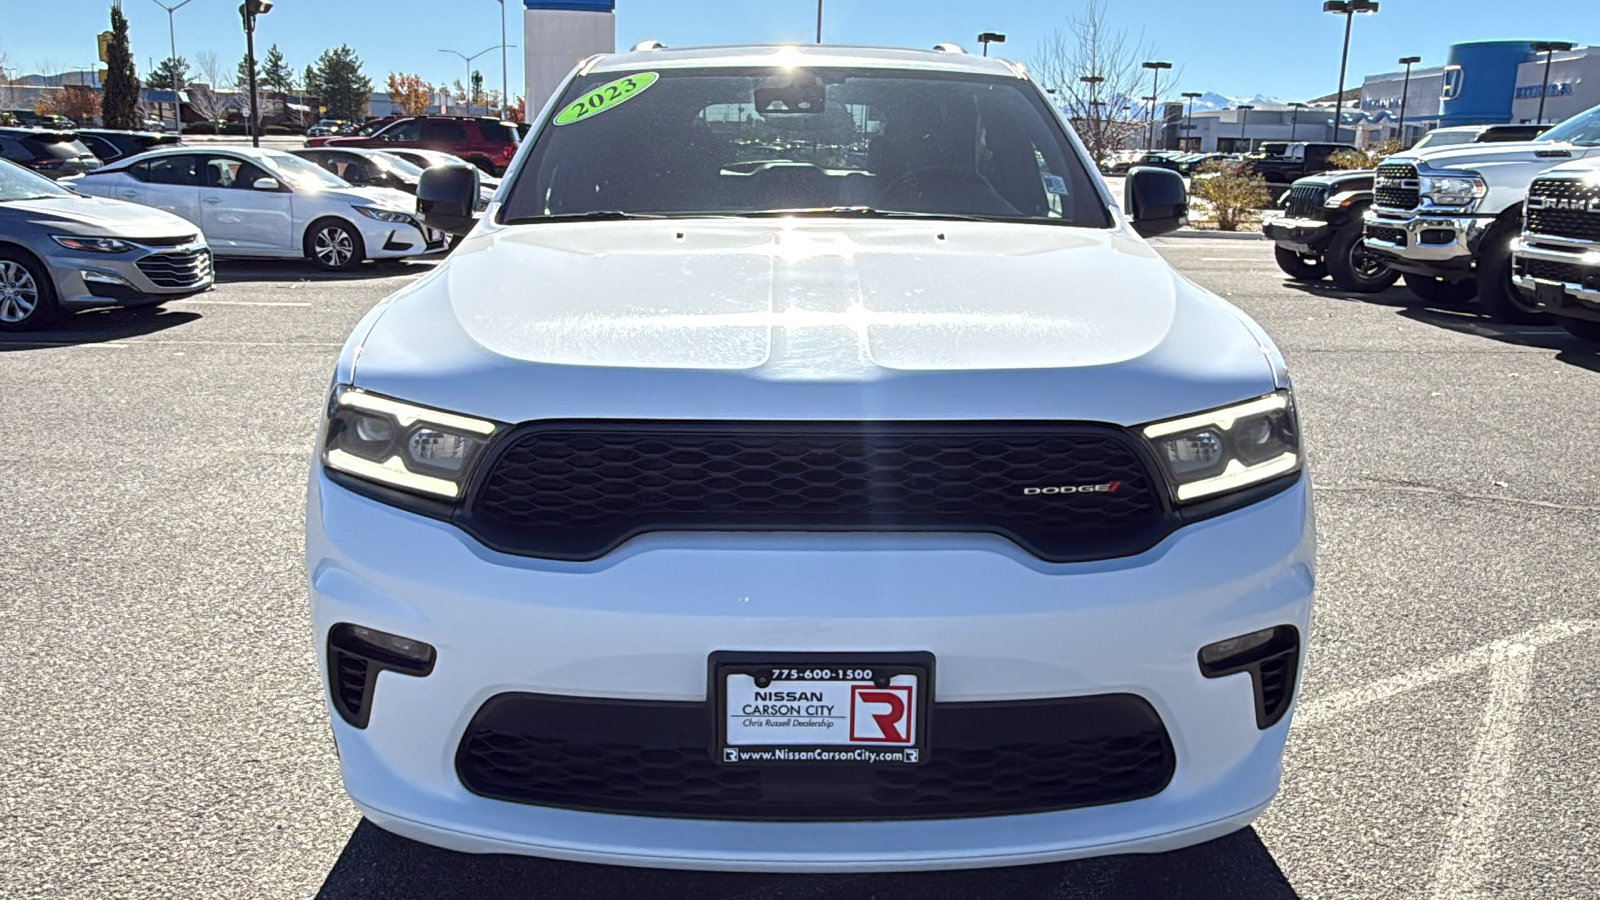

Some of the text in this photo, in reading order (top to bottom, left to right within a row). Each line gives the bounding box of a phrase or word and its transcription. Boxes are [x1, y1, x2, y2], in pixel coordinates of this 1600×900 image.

[572, 79, 637, 118] 2023
[1545, 198, 1585, 210] RAM
[1023, 483, 1110, 495] DODGE
[772, 669, 873, 680] 775-600-1500
[754, 691, 823, 703] NISSAN
[742, 704, 834, 716] CARSON CITY
[743, 718, 834, 729] Chris Russell Dealership
[740, 749, 903, 763] www.NissanCarsonCity.com
